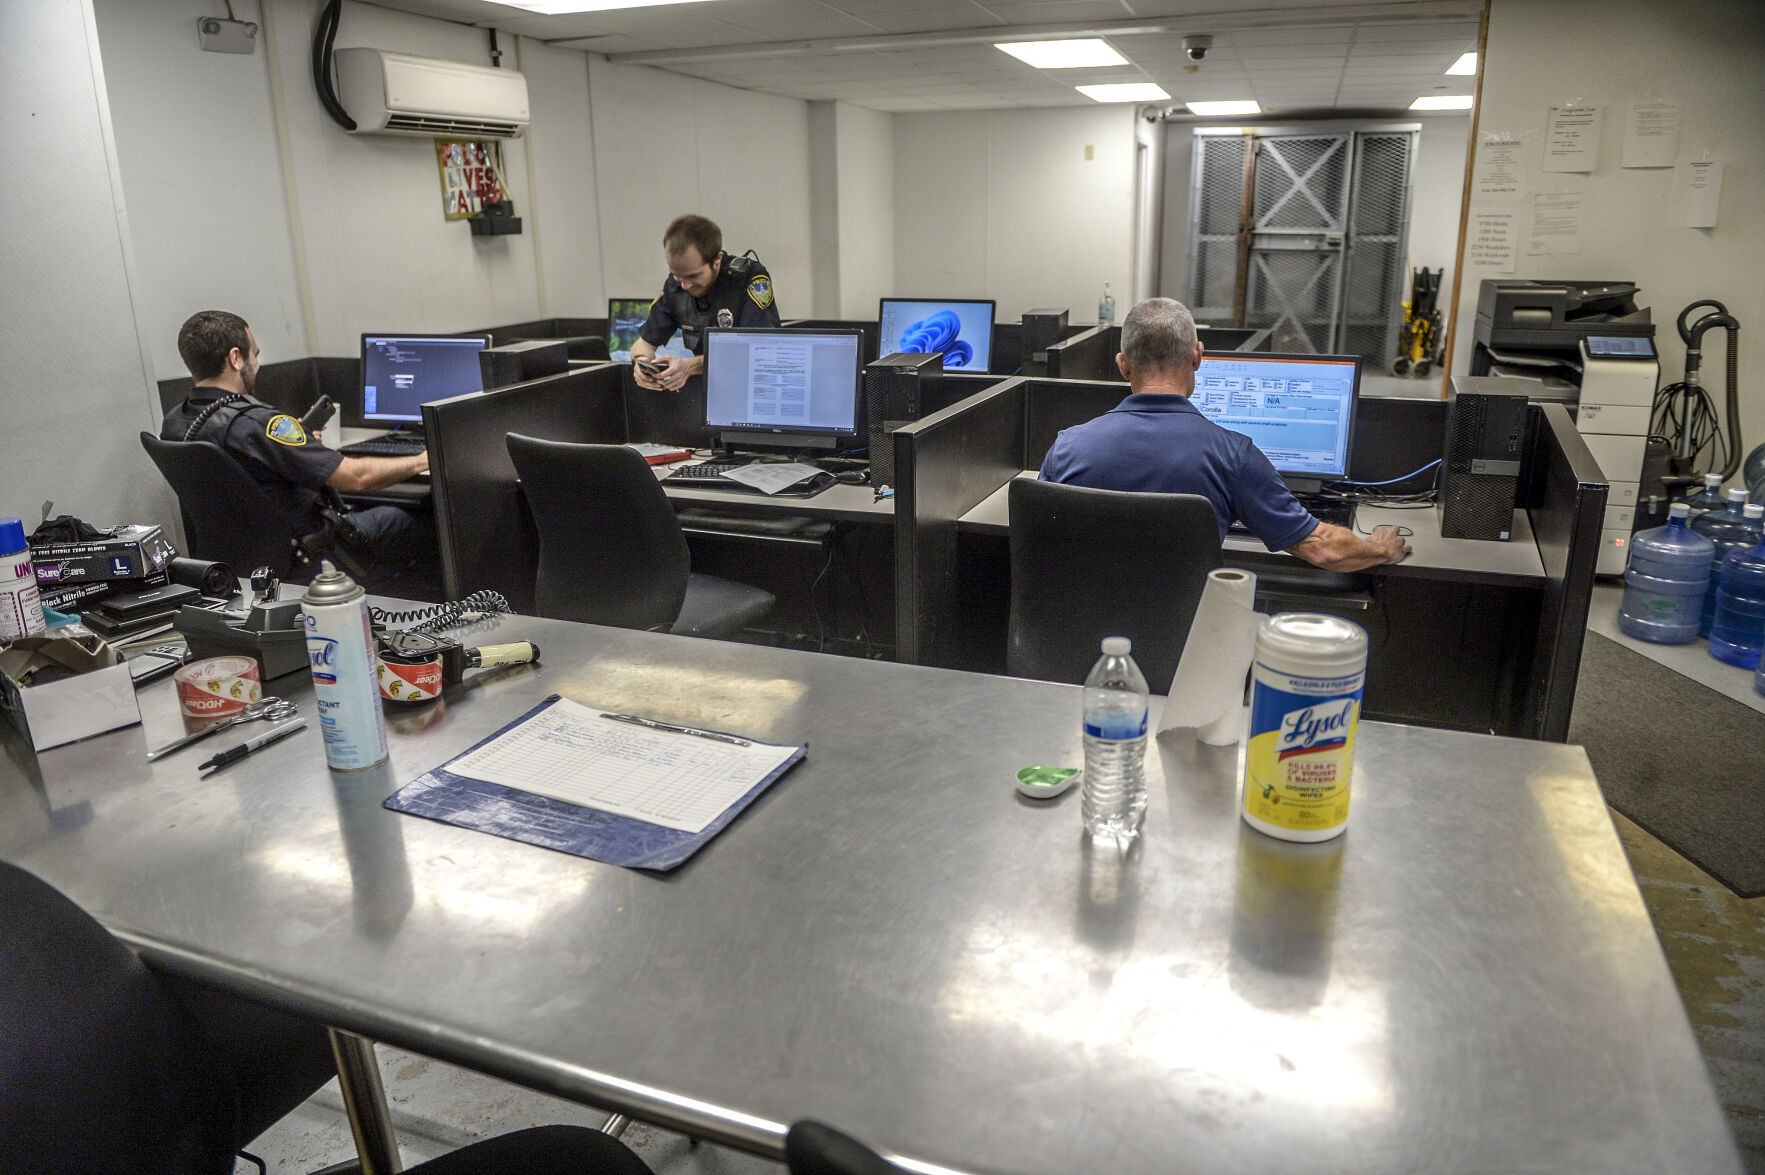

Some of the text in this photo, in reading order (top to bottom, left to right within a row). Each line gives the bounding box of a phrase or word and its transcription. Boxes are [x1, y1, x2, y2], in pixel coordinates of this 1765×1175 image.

[115, 558, 127, 570] L
[62, 589, 86, 602] Nitrile
[1284, 701, 1352, 746] Lysol
[1288, 761, 1312, 769] KILLS
